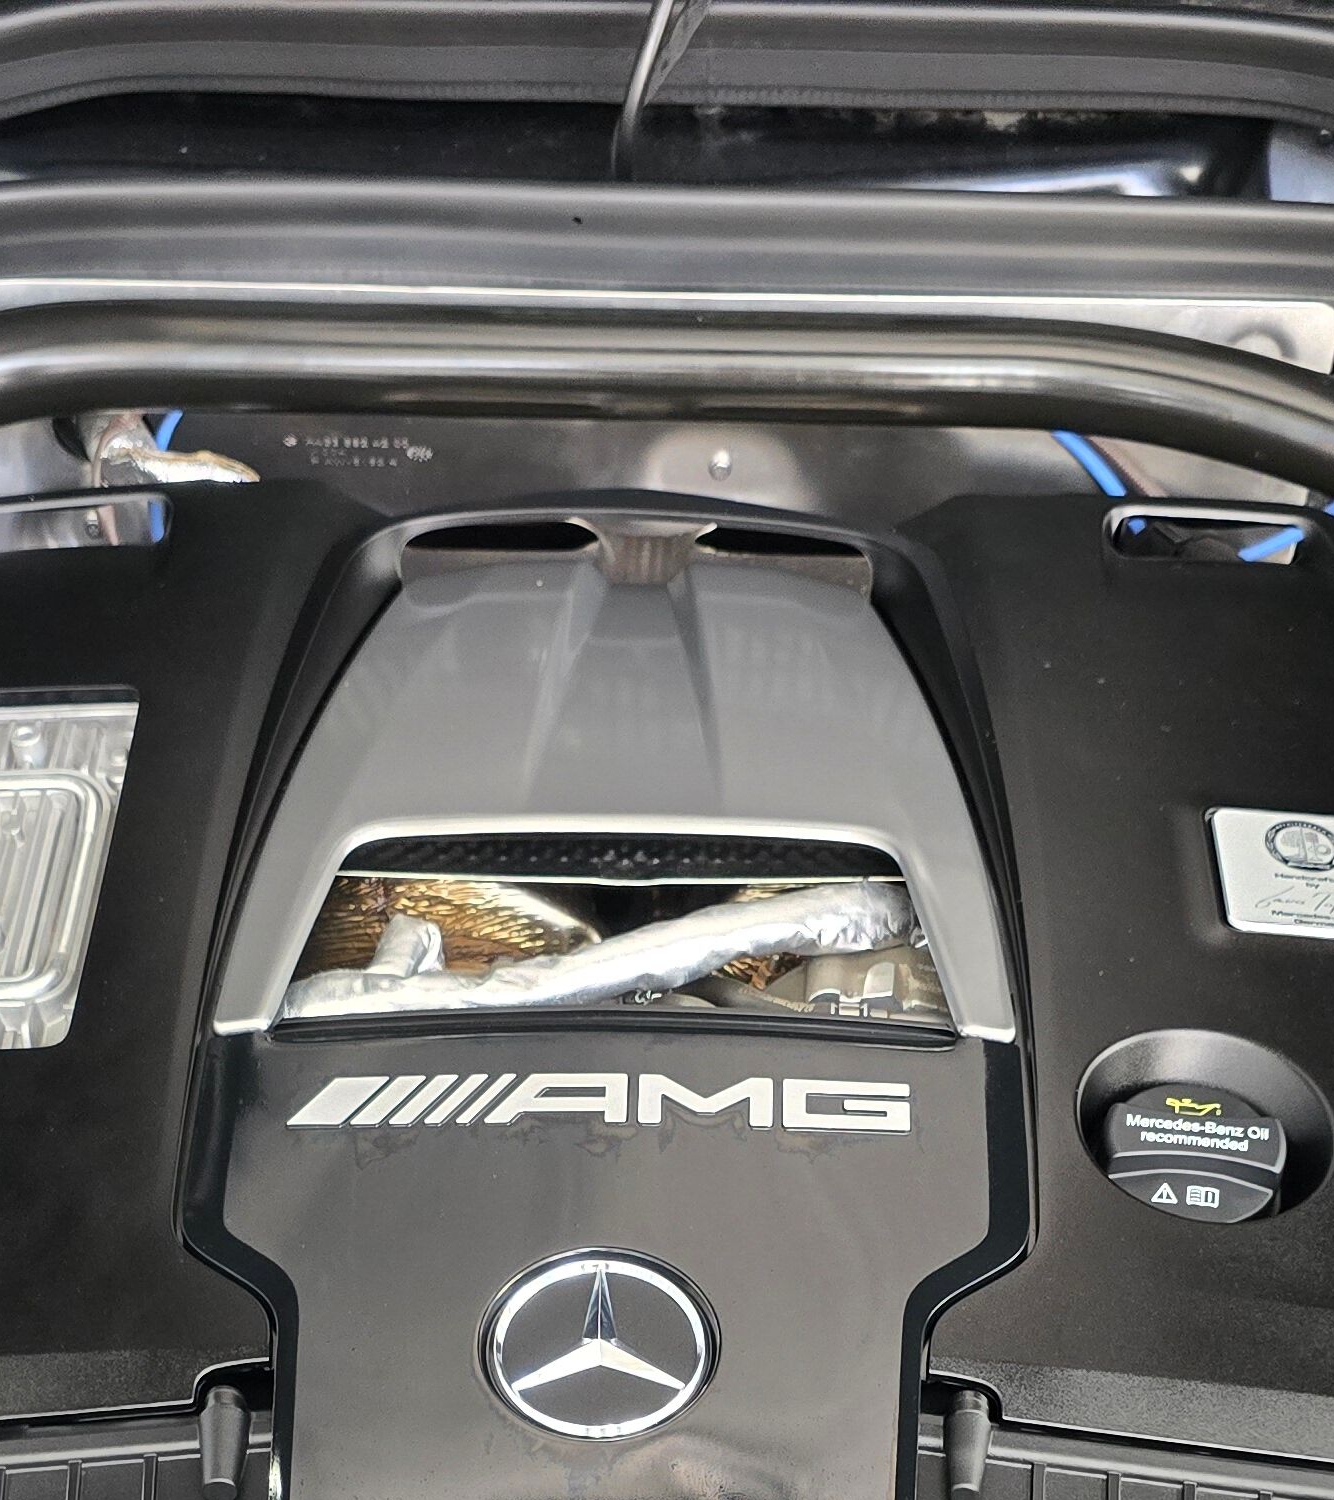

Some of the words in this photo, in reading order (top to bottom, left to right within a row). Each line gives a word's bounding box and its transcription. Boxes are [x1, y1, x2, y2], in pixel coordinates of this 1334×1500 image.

[483, 1073, 911, 1132] AMG
[1126, 1113, 1245, 1138] Mercedes-Benz
[1247, 1126, 1269, 1140] Oil
[1140, 1131, 1248, 1152] recommended
